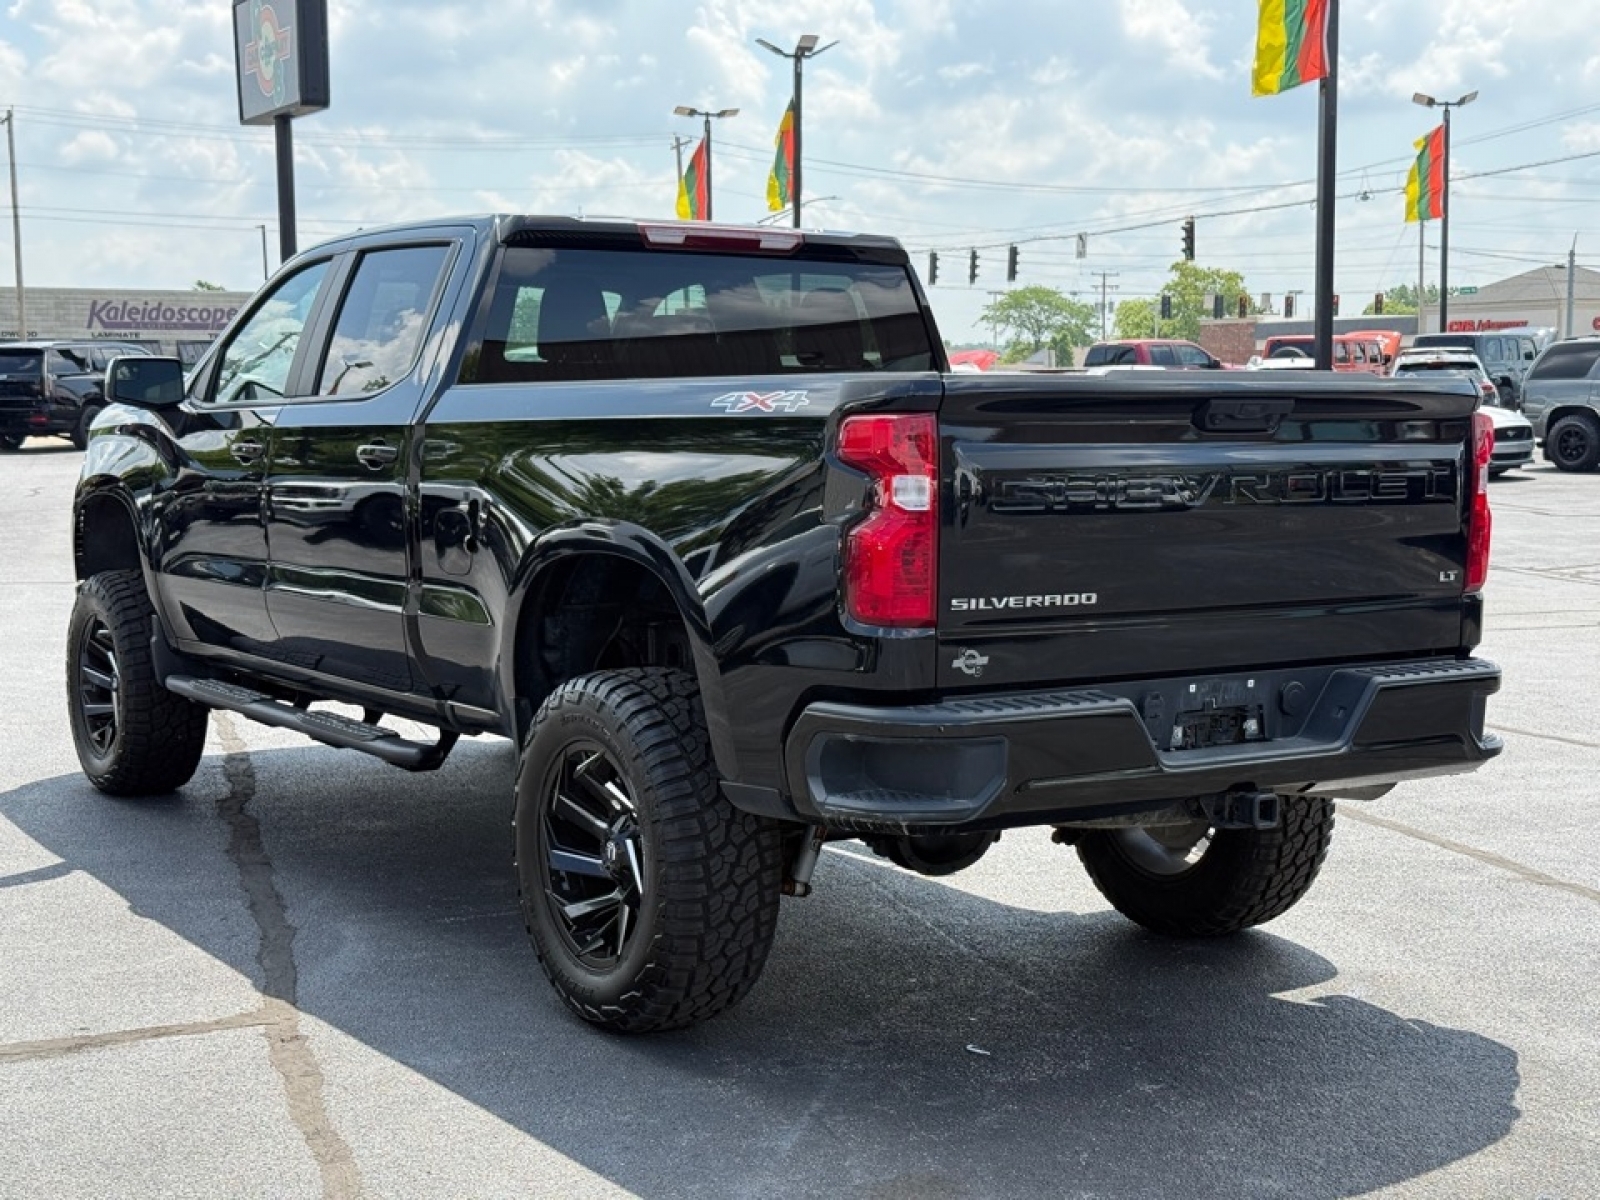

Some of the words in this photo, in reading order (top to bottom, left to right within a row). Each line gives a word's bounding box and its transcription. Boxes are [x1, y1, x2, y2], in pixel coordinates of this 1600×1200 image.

[86, 299, 239, 329] Kaleidoscope
[991, 467, 1451, 511] CHEVROLET
[1440, 570, 1458, 582] LT
[951, 593, 1098, 611] SILVERADO
